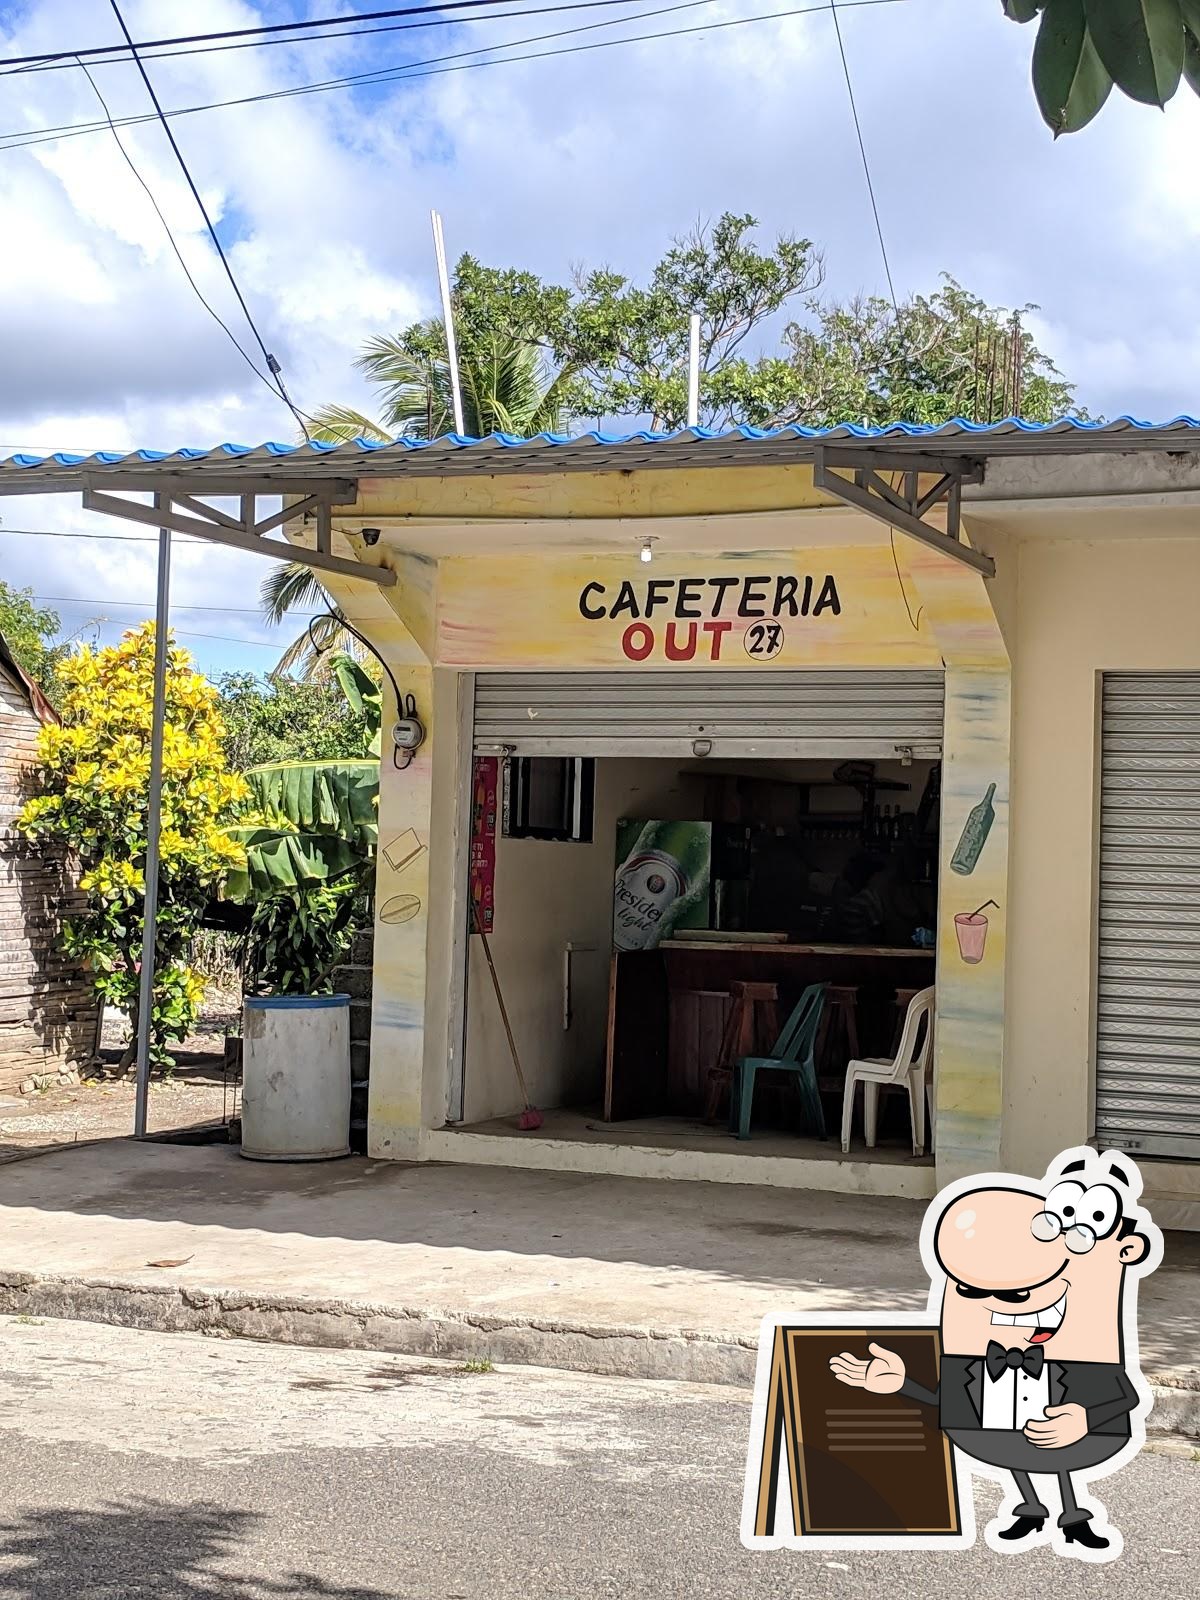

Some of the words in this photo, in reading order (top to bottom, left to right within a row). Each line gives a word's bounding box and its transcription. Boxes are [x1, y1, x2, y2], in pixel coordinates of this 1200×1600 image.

[579, 575, 841, 619] CAFETERIA
[622, 622, 732, 661] OUT
[749, 625, 781, 654] 27
[617, 907, 653, 931] light
